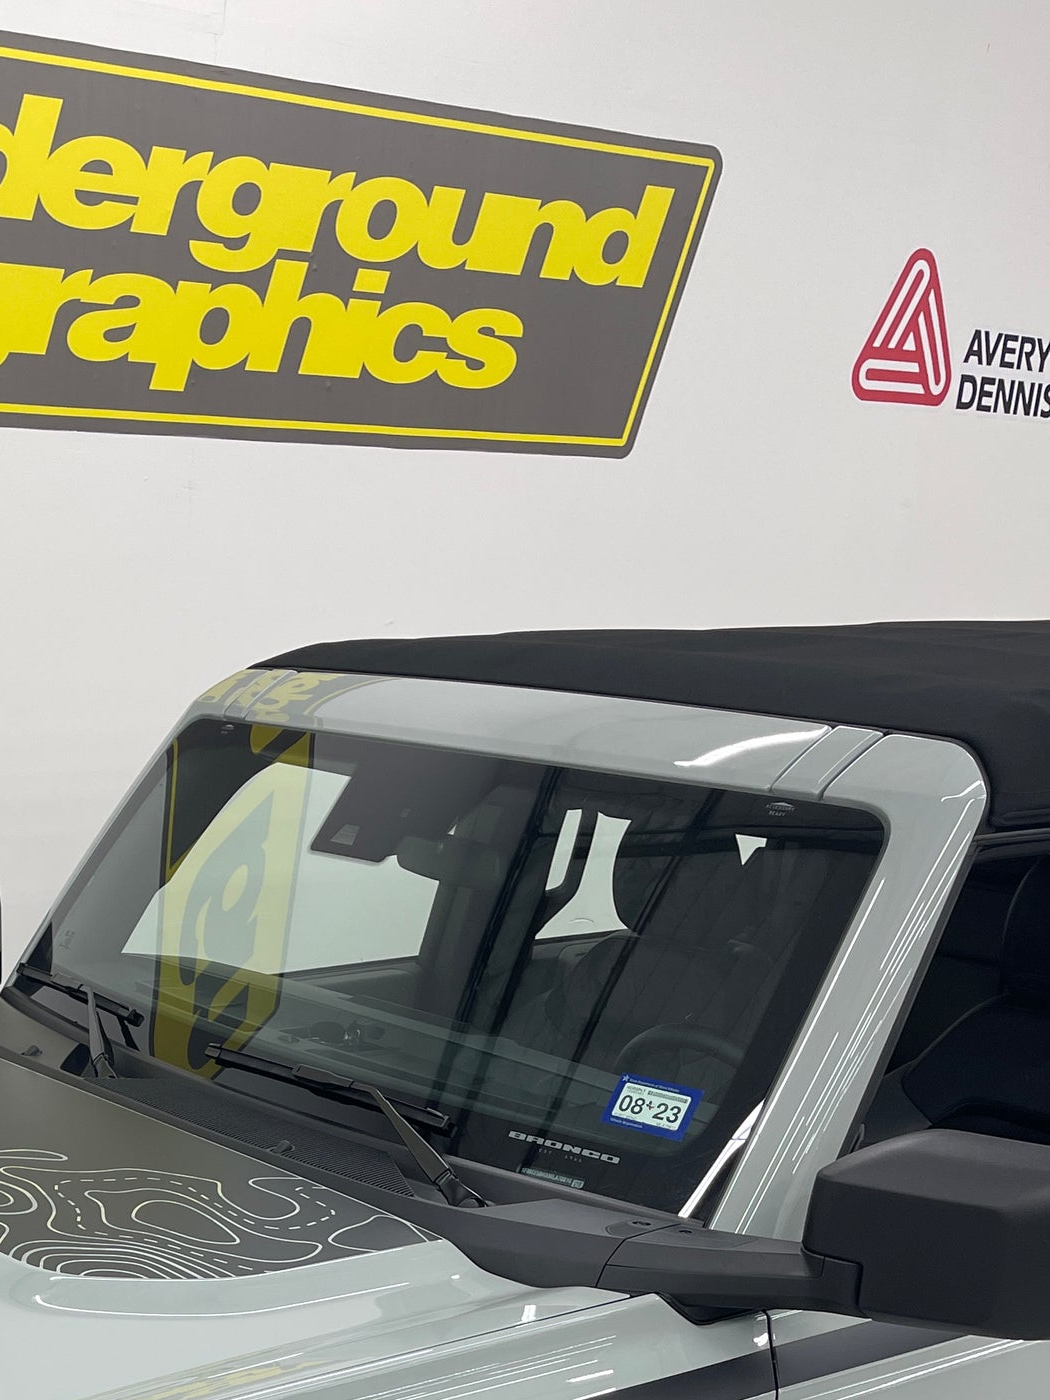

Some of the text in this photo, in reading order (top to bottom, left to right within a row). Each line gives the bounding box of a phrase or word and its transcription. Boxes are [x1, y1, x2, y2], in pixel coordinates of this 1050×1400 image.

[963, 328, 1050, 373] AVERY
[618, 1094, 646, 1115] 08
[652, 1102, 682, 1124] 23
[508, 1130, 621, 1165] BRONCO
